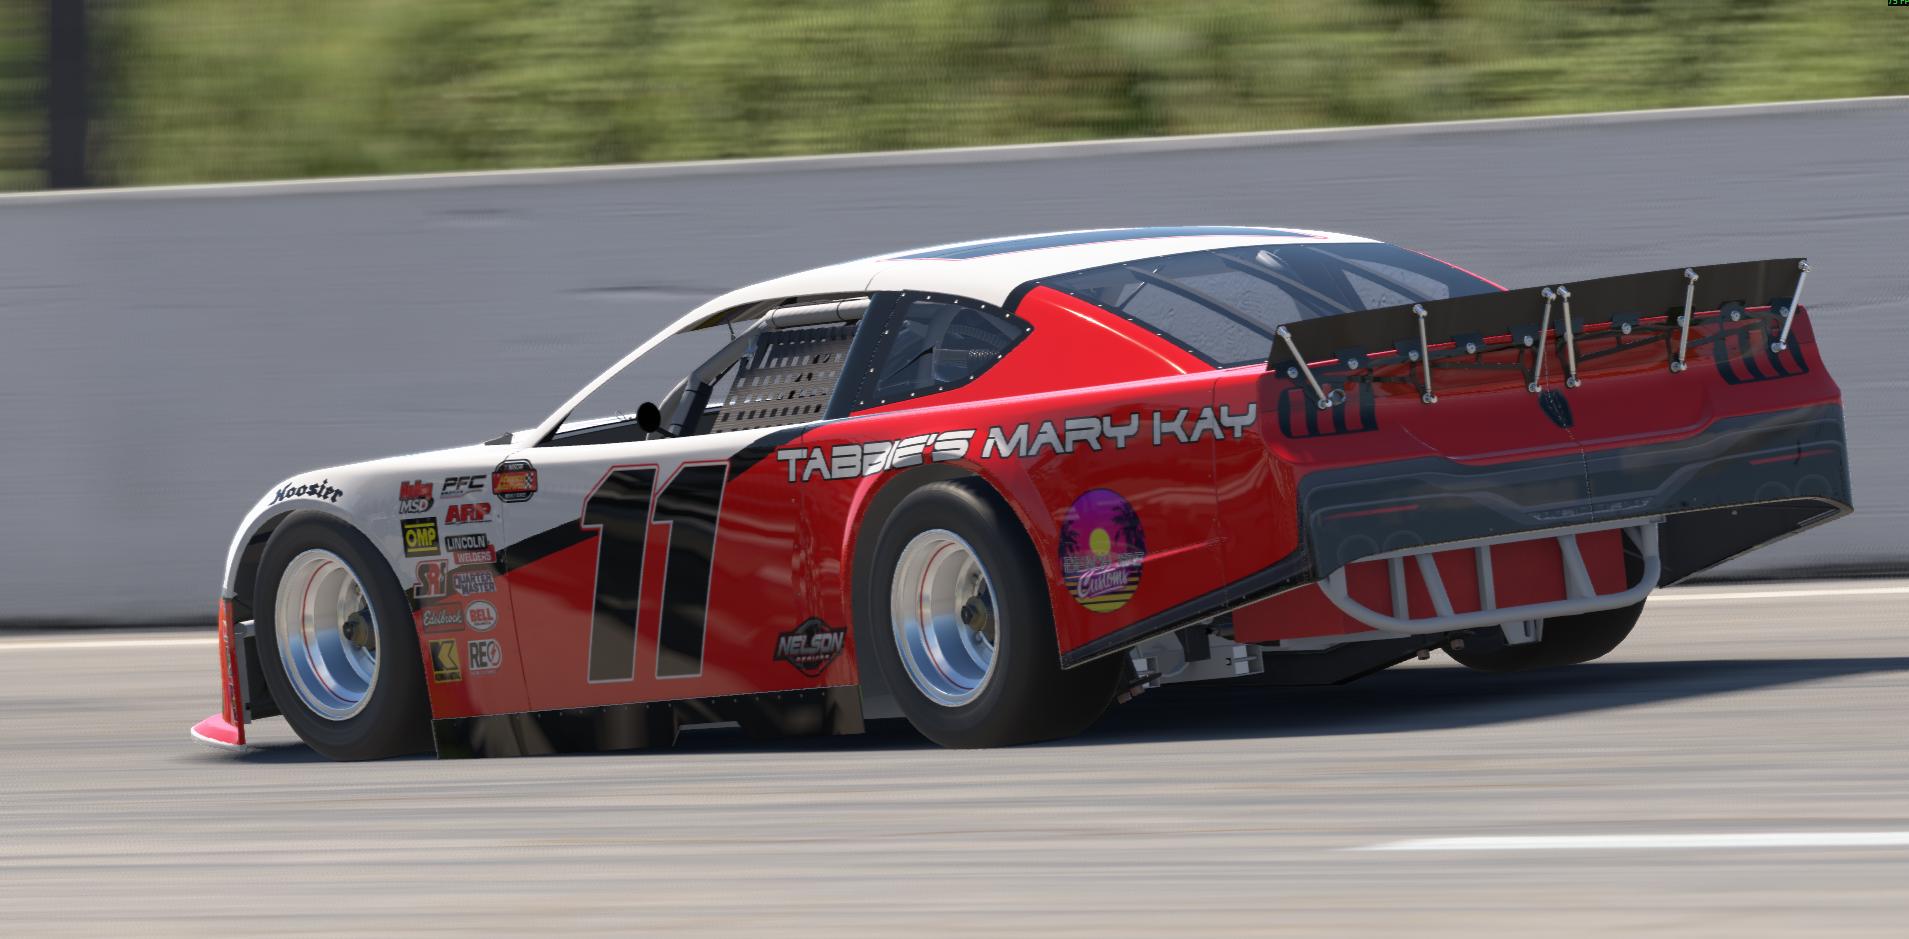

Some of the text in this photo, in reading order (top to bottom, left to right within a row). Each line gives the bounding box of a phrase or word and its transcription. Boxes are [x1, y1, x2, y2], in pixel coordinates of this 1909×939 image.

[776, 403, 1257, 483] TABBIE'S MARY KAY
[268, 478, 343, 505] Hoosier
[442, 475, 487, 491] PFC
[399, 498, 432, 514] MSD
[445, 503, 492, 525] ARP
[405, 527, 437, 547] OMP
[446, 535, 485, 549] LINCOLN
[456, 551, 492, 562] WELDERS
[581, 459, 730, 684] 11
[461, 581, 496, 594] MASTER
[469, 608, 494, 622] BELL
[776, 631, 844, 656] NELSON
